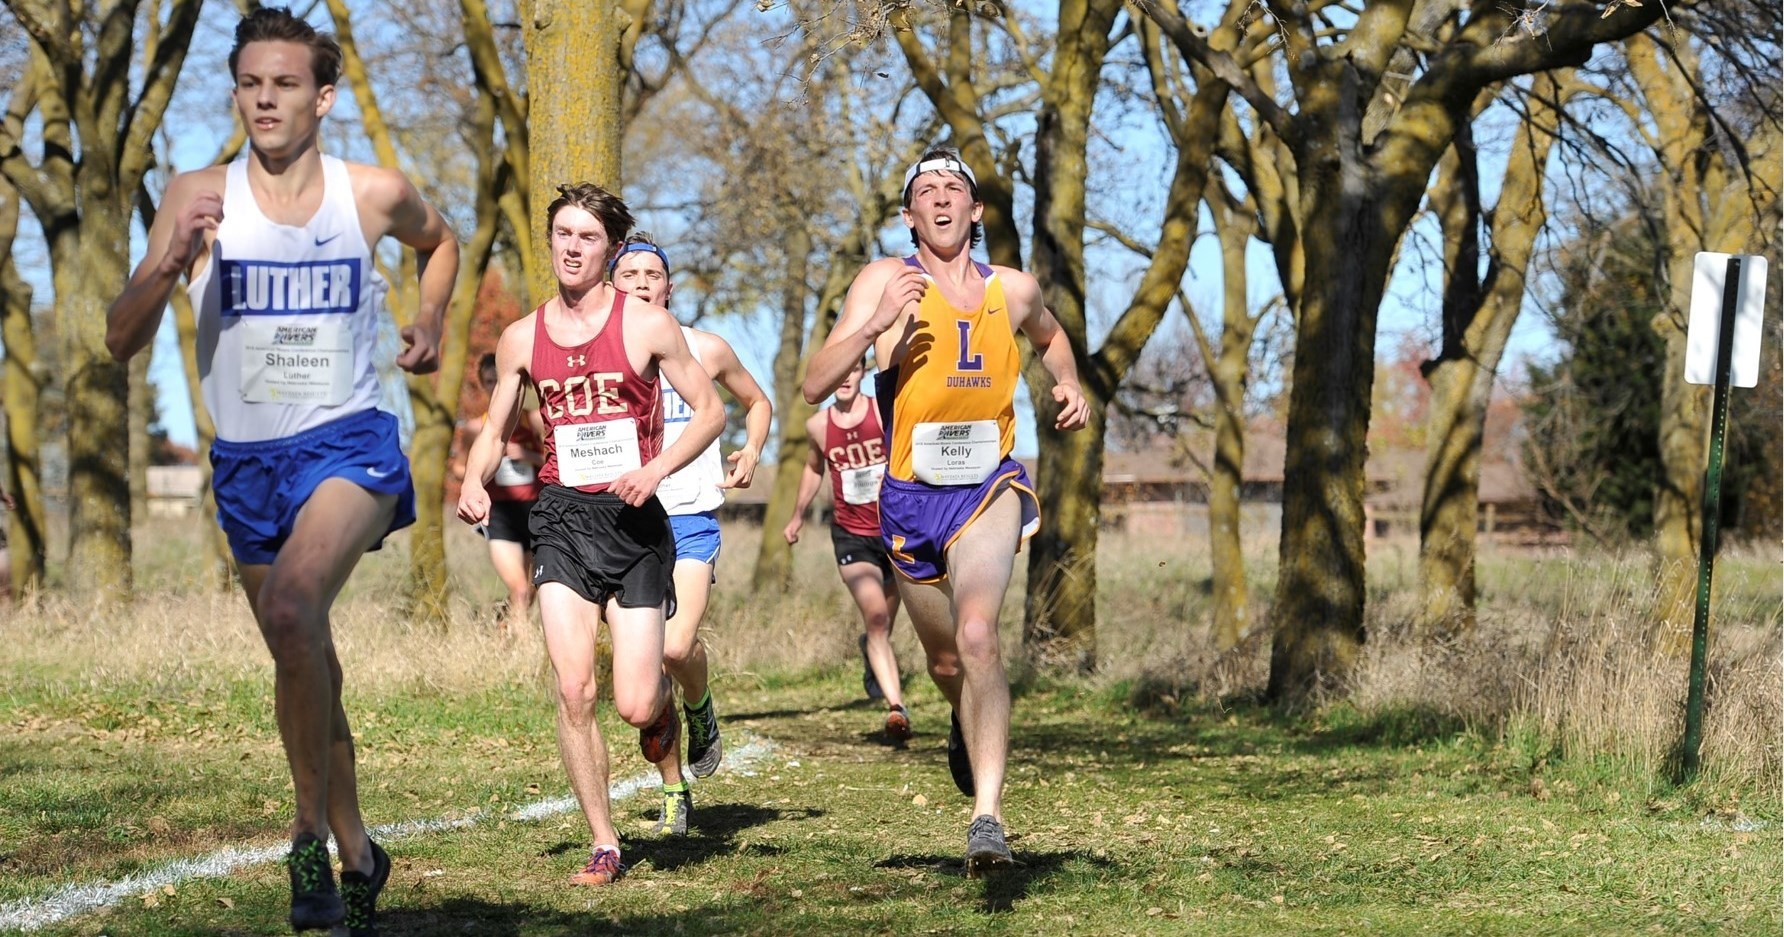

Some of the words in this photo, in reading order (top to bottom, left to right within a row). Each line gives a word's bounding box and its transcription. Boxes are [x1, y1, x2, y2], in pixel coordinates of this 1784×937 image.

[230, 264, 352, 310] LUTHER
[956, 319, 984, 372] L
[265, 353, 330, 367] Shaleen
[283, 371, 311, 379] Luther
[946, 376, 992, 388] DUHAWKS
[538, 372, 629, 420] COE
[570, 443, 623, 458] Meshach
[829, 437, 888, 471] COE
[941, 446, 972, 458] Kelly
[892, 534, 915, 564] L
